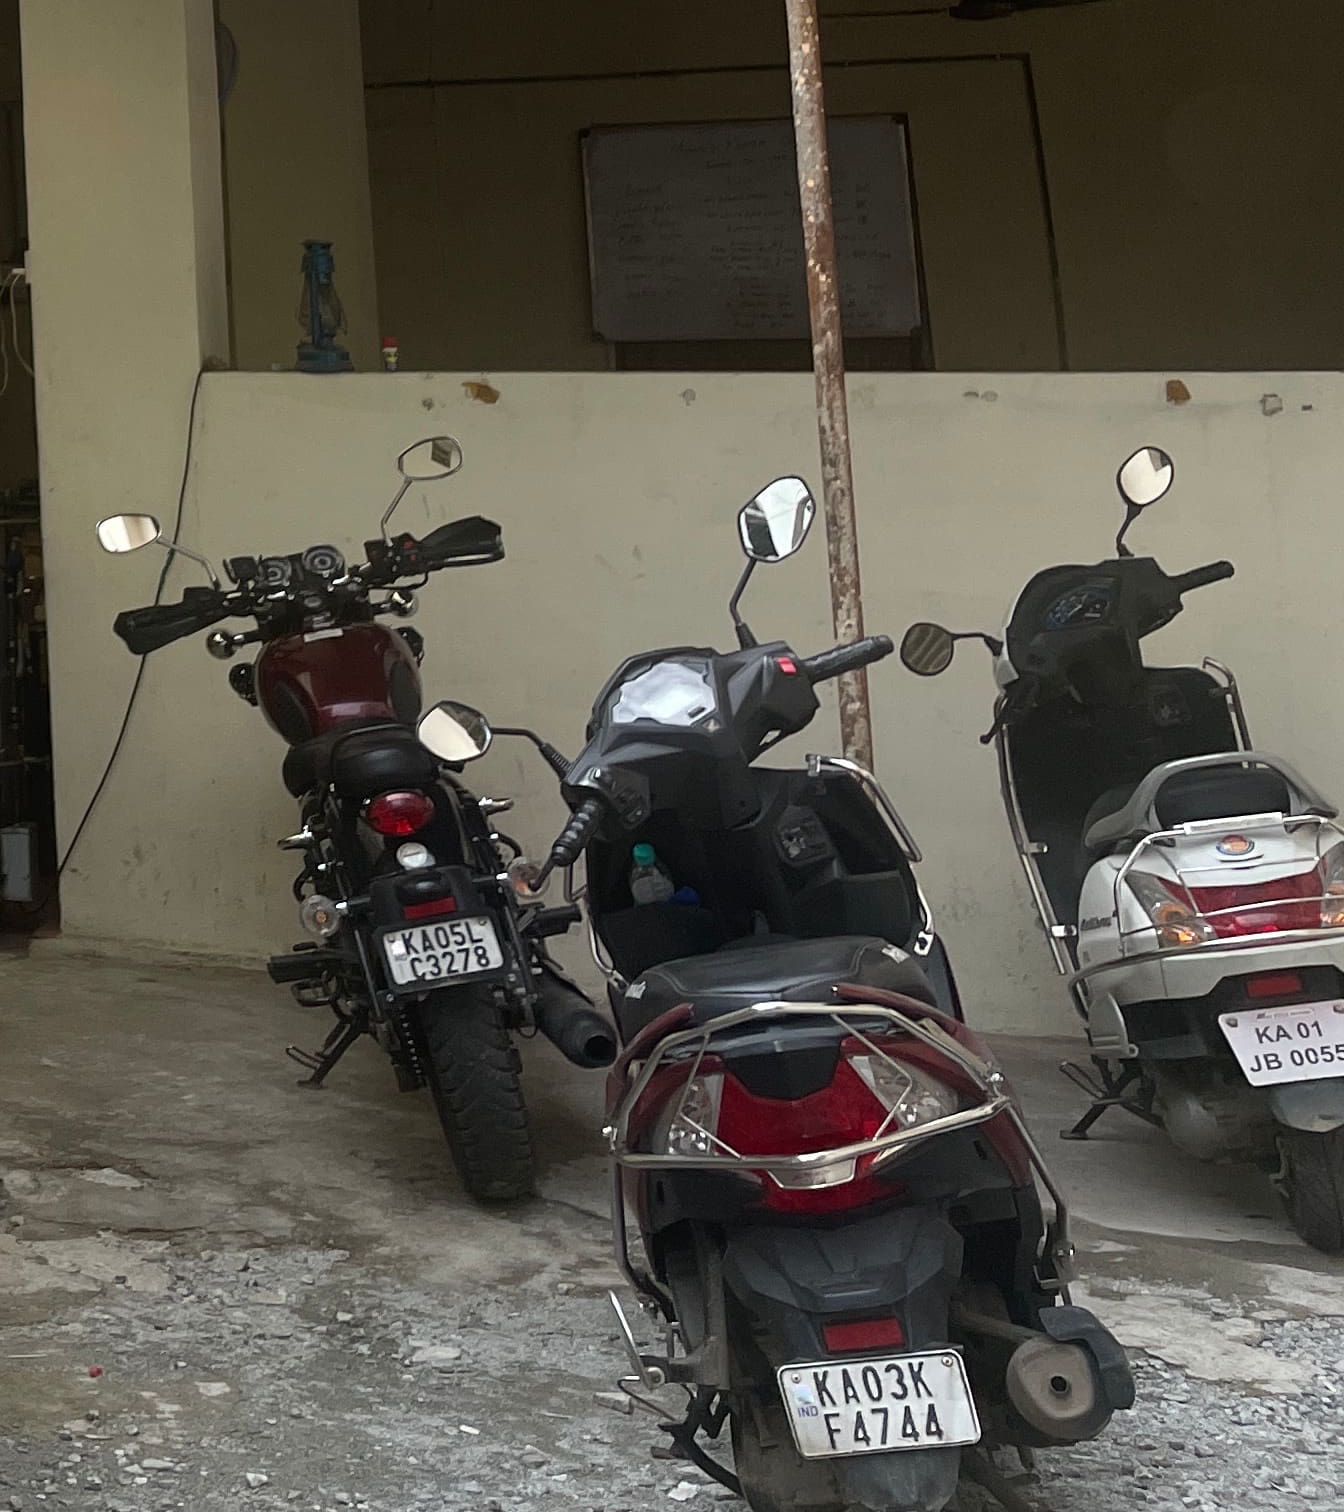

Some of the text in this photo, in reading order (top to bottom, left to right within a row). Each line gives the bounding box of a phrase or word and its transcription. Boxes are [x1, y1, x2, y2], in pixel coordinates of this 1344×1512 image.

[401, 920, 483, 955] KA05L
[410, 945, 490, 979] C3278
[1255, 1020, 1323, 1044] KA 01
[1250, 1044, 1344, 1072] JB 0055
[813, 1360, 933, 1407] KA03K
[823, 1404, 944, 1450] F4744
